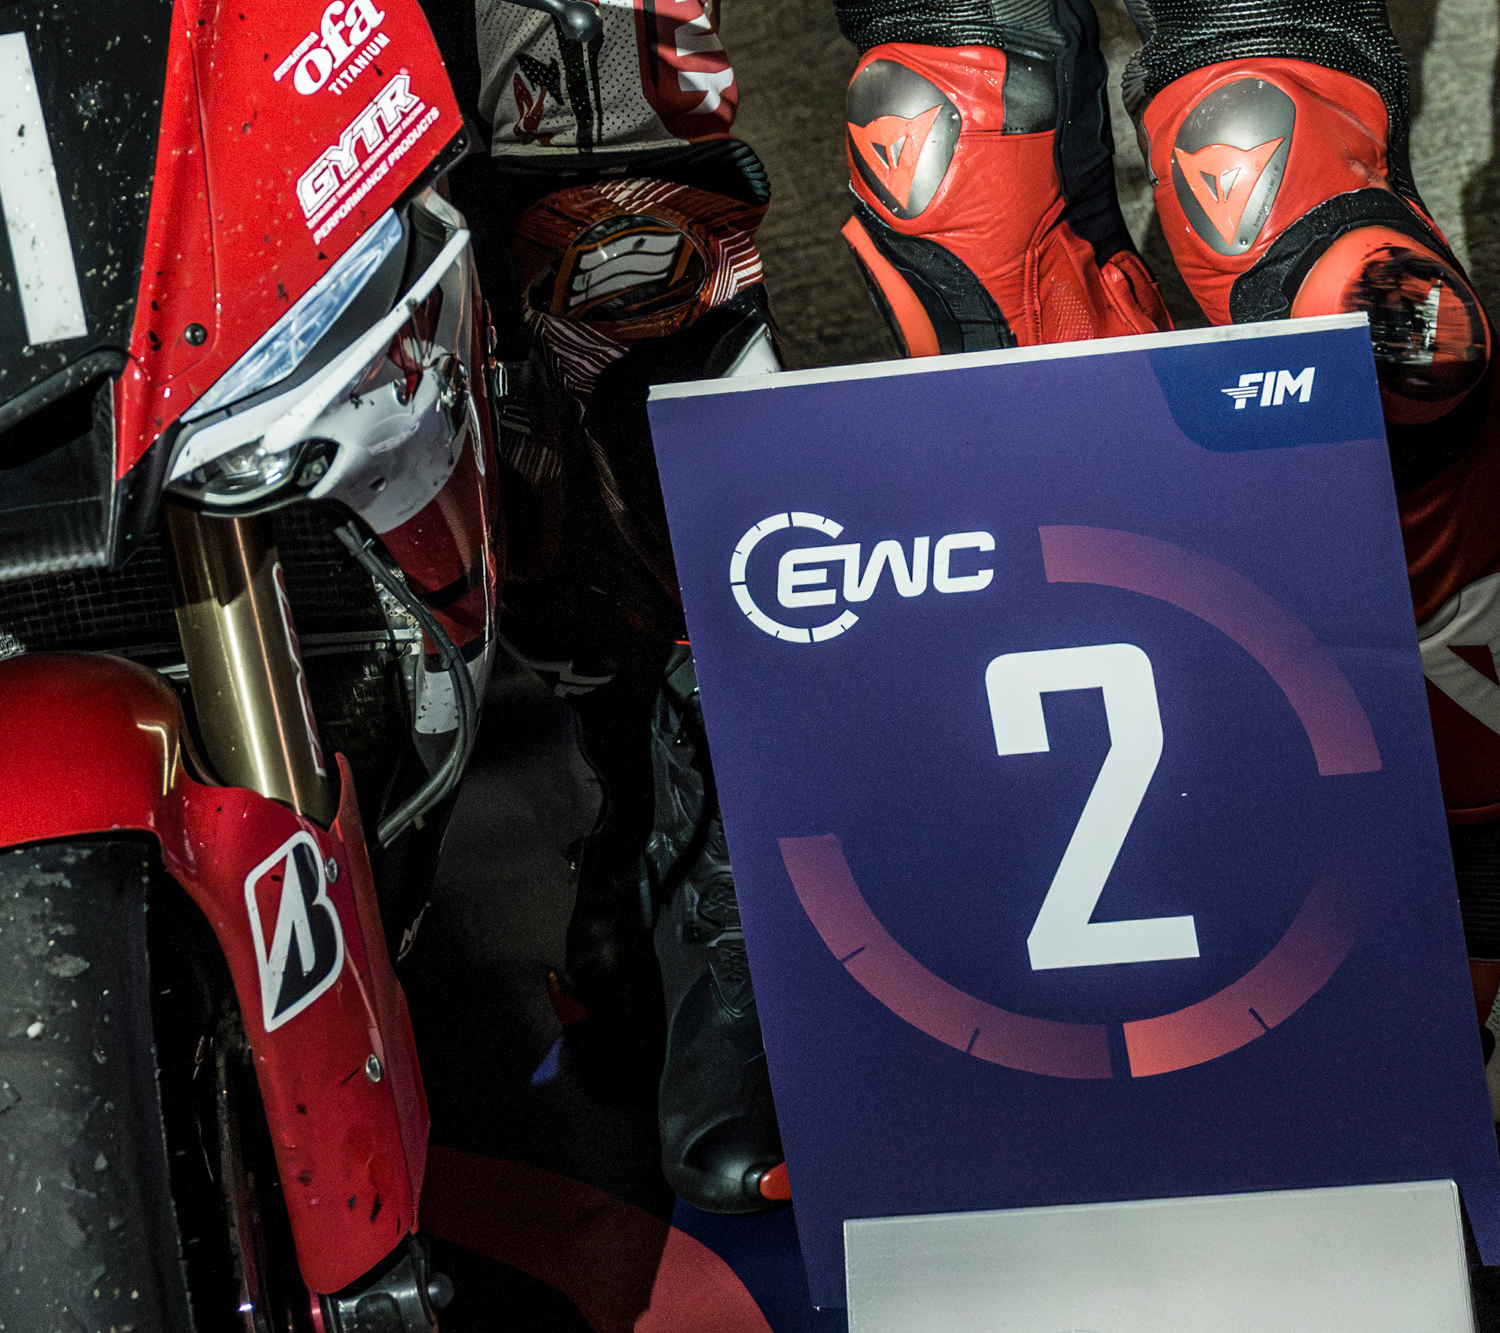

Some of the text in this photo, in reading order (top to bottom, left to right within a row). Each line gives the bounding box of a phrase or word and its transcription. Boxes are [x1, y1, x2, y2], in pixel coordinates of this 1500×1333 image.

[328, 32, 390, 95] TITANIUM
[296, 74, 420, 218] GYTR
[313, 162, 389, 245] PERFORMANCE
[389, 107, 440, 167] PRODUCTS
[1221, 366, 1315, 410] FIM
[984, 642, 1200, 972] 2
